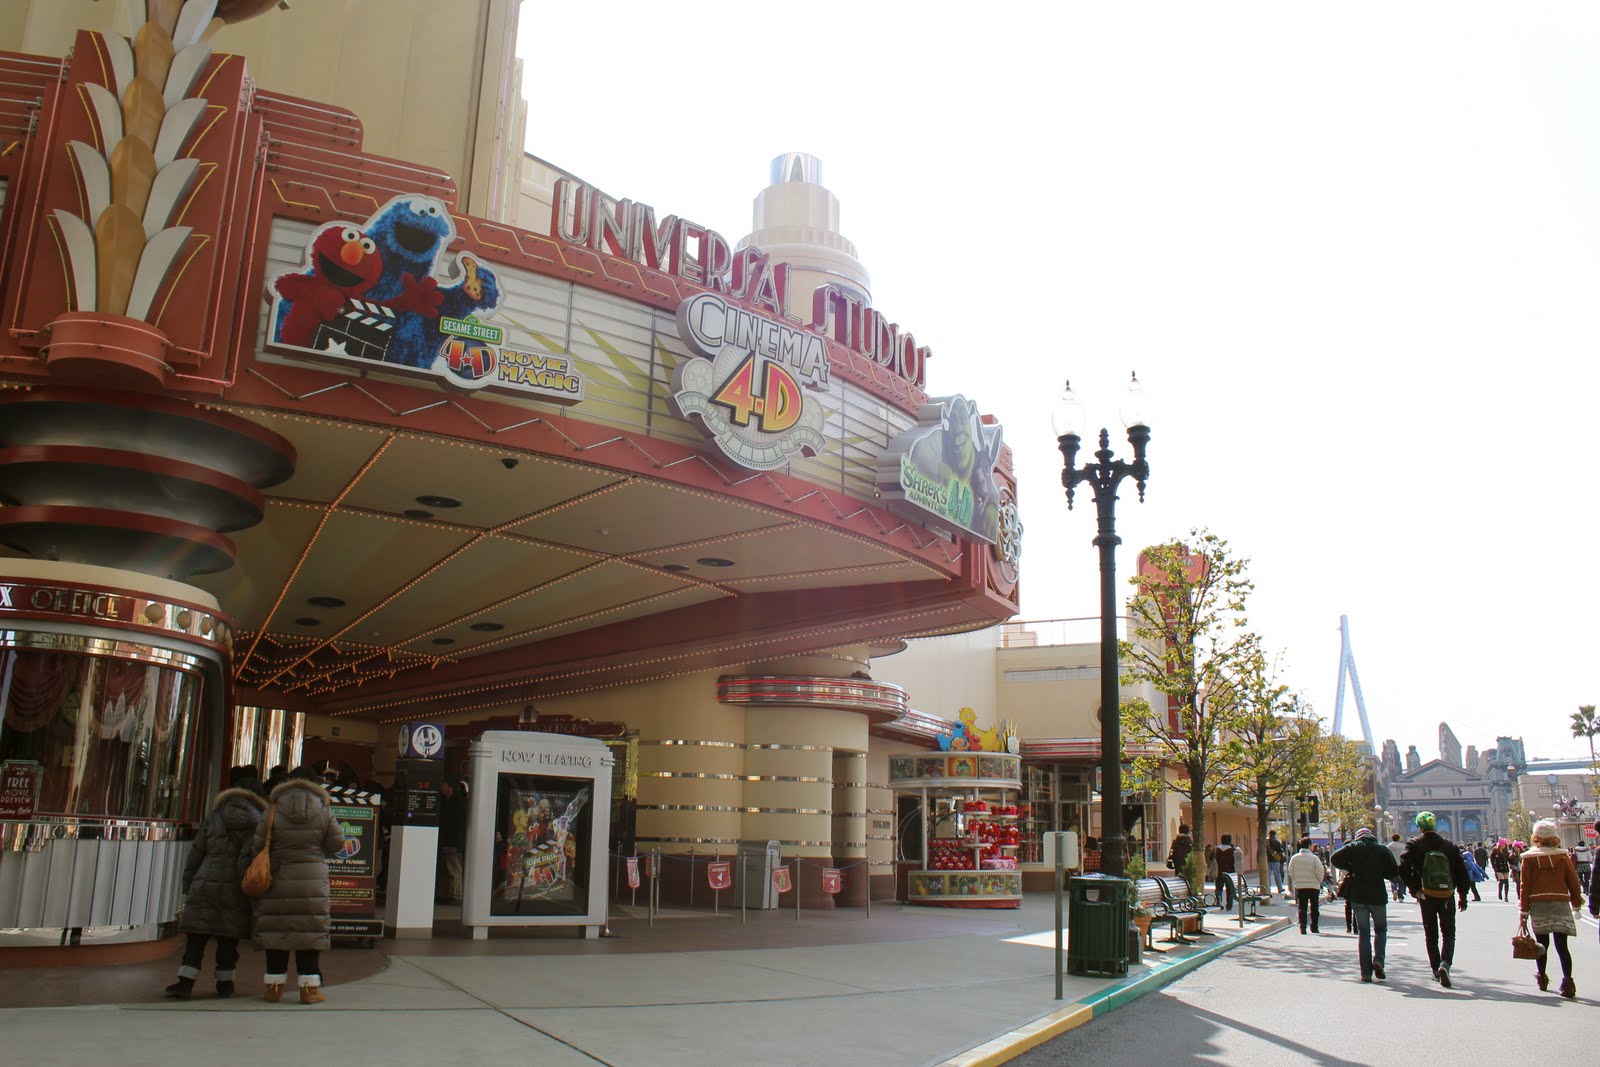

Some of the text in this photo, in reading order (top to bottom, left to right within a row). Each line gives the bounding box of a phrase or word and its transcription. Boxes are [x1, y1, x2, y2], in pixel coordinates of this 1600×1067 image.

[551, 177, 932, 392] UNIVERSAL STUDIOS
[443, 320, 499, 340] SESAME STREET
[688, 293, 828, 384] CINEMA
[499, 348, 568, 373] MOVIE
[498, 363, 580, 393] MAGIC
[31, 589, 121, 617] OFFICE
[502, 750, 592, 768] NOW PLAYING
[4, 789, 29, 797] MOVIE
[7, 777, 30, 788] FREE
